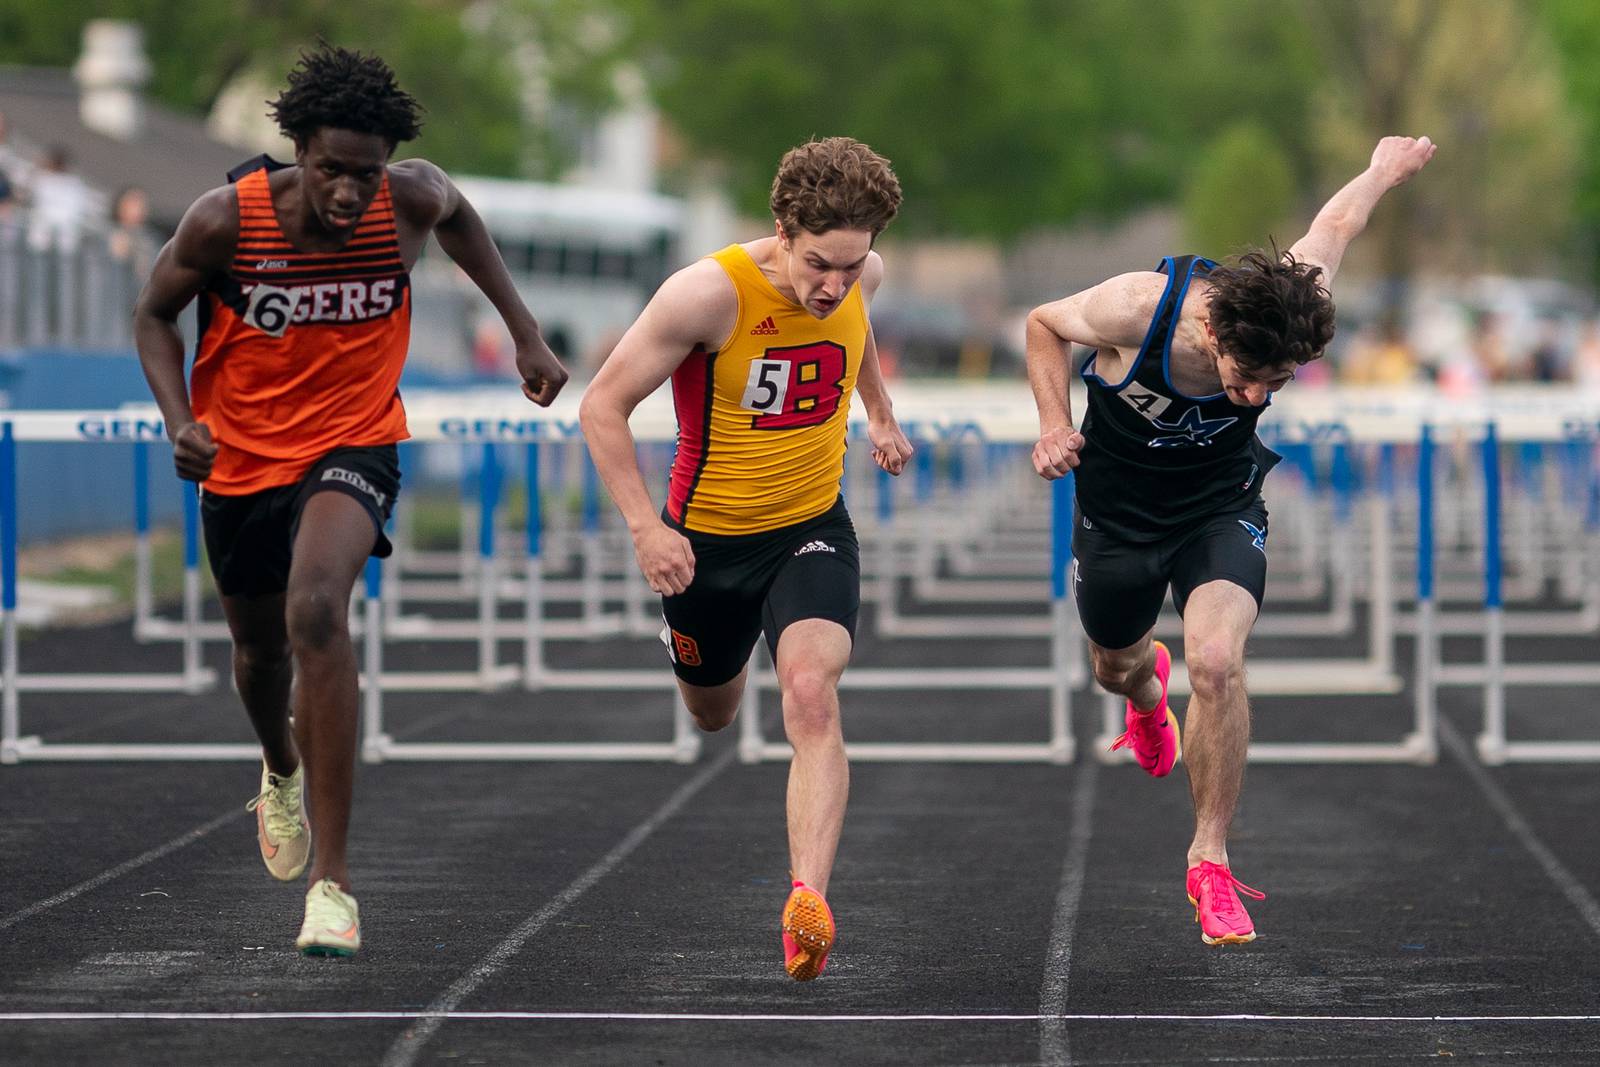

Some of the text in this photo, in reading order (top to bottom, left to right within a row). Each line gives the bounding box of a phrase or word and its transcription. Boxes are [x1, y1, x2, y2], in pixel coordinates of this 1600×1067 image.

[240, 280, 396, 323] GERS
[253, 292, 290, 332] 6
[750, 328, 779, 336] adidas
[751, 340, 847, 431] B
[751, 363, 782, 410] 5
[1127, 393, 1160, 413] 4
[439, 418, 580, 437] GENEV
[672, 629, 702, 666] B
